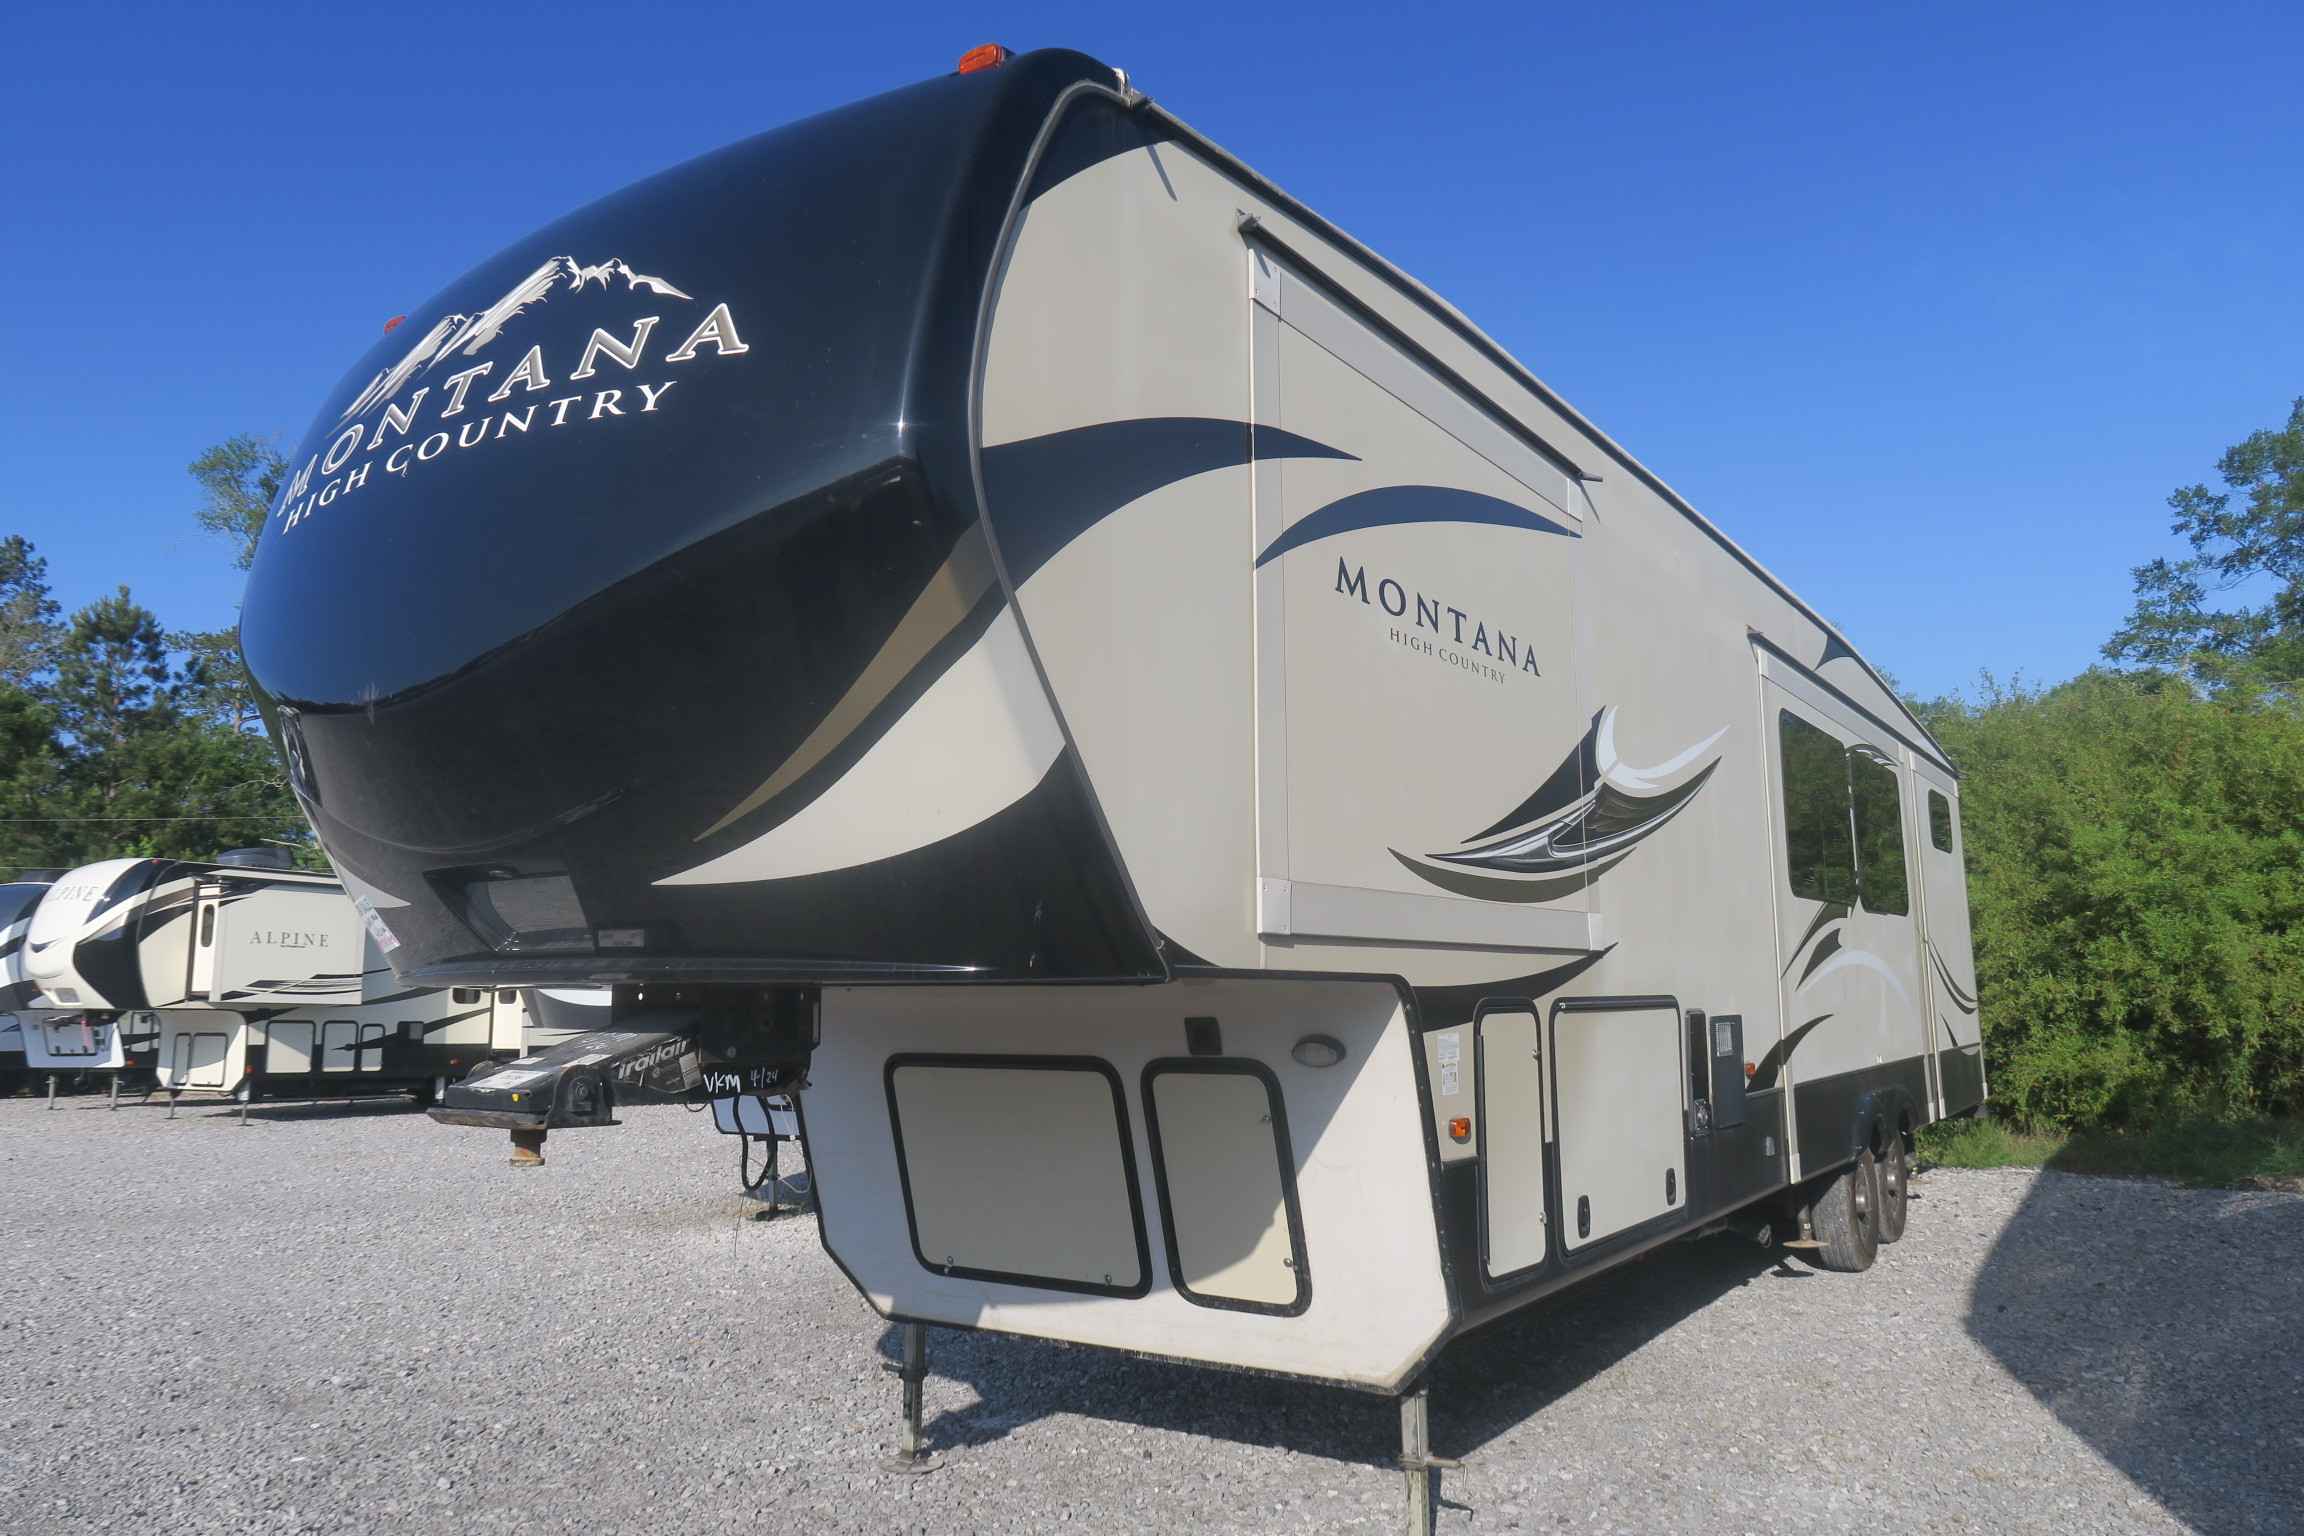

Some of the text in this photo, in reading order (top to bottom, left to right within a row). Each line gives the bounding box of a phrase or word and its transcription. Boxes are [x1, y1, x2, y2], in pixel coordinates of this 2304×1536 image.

[277, 303, 749, 517] MONTANA
[282, 381, 677, 535] HIGH COUNTRY
[1335, 556, 1541, 677] MONTANA
[1390, 627, 1506, 684] HIGH COUNTRY
[249, 931, 329, 947] ALPINE
